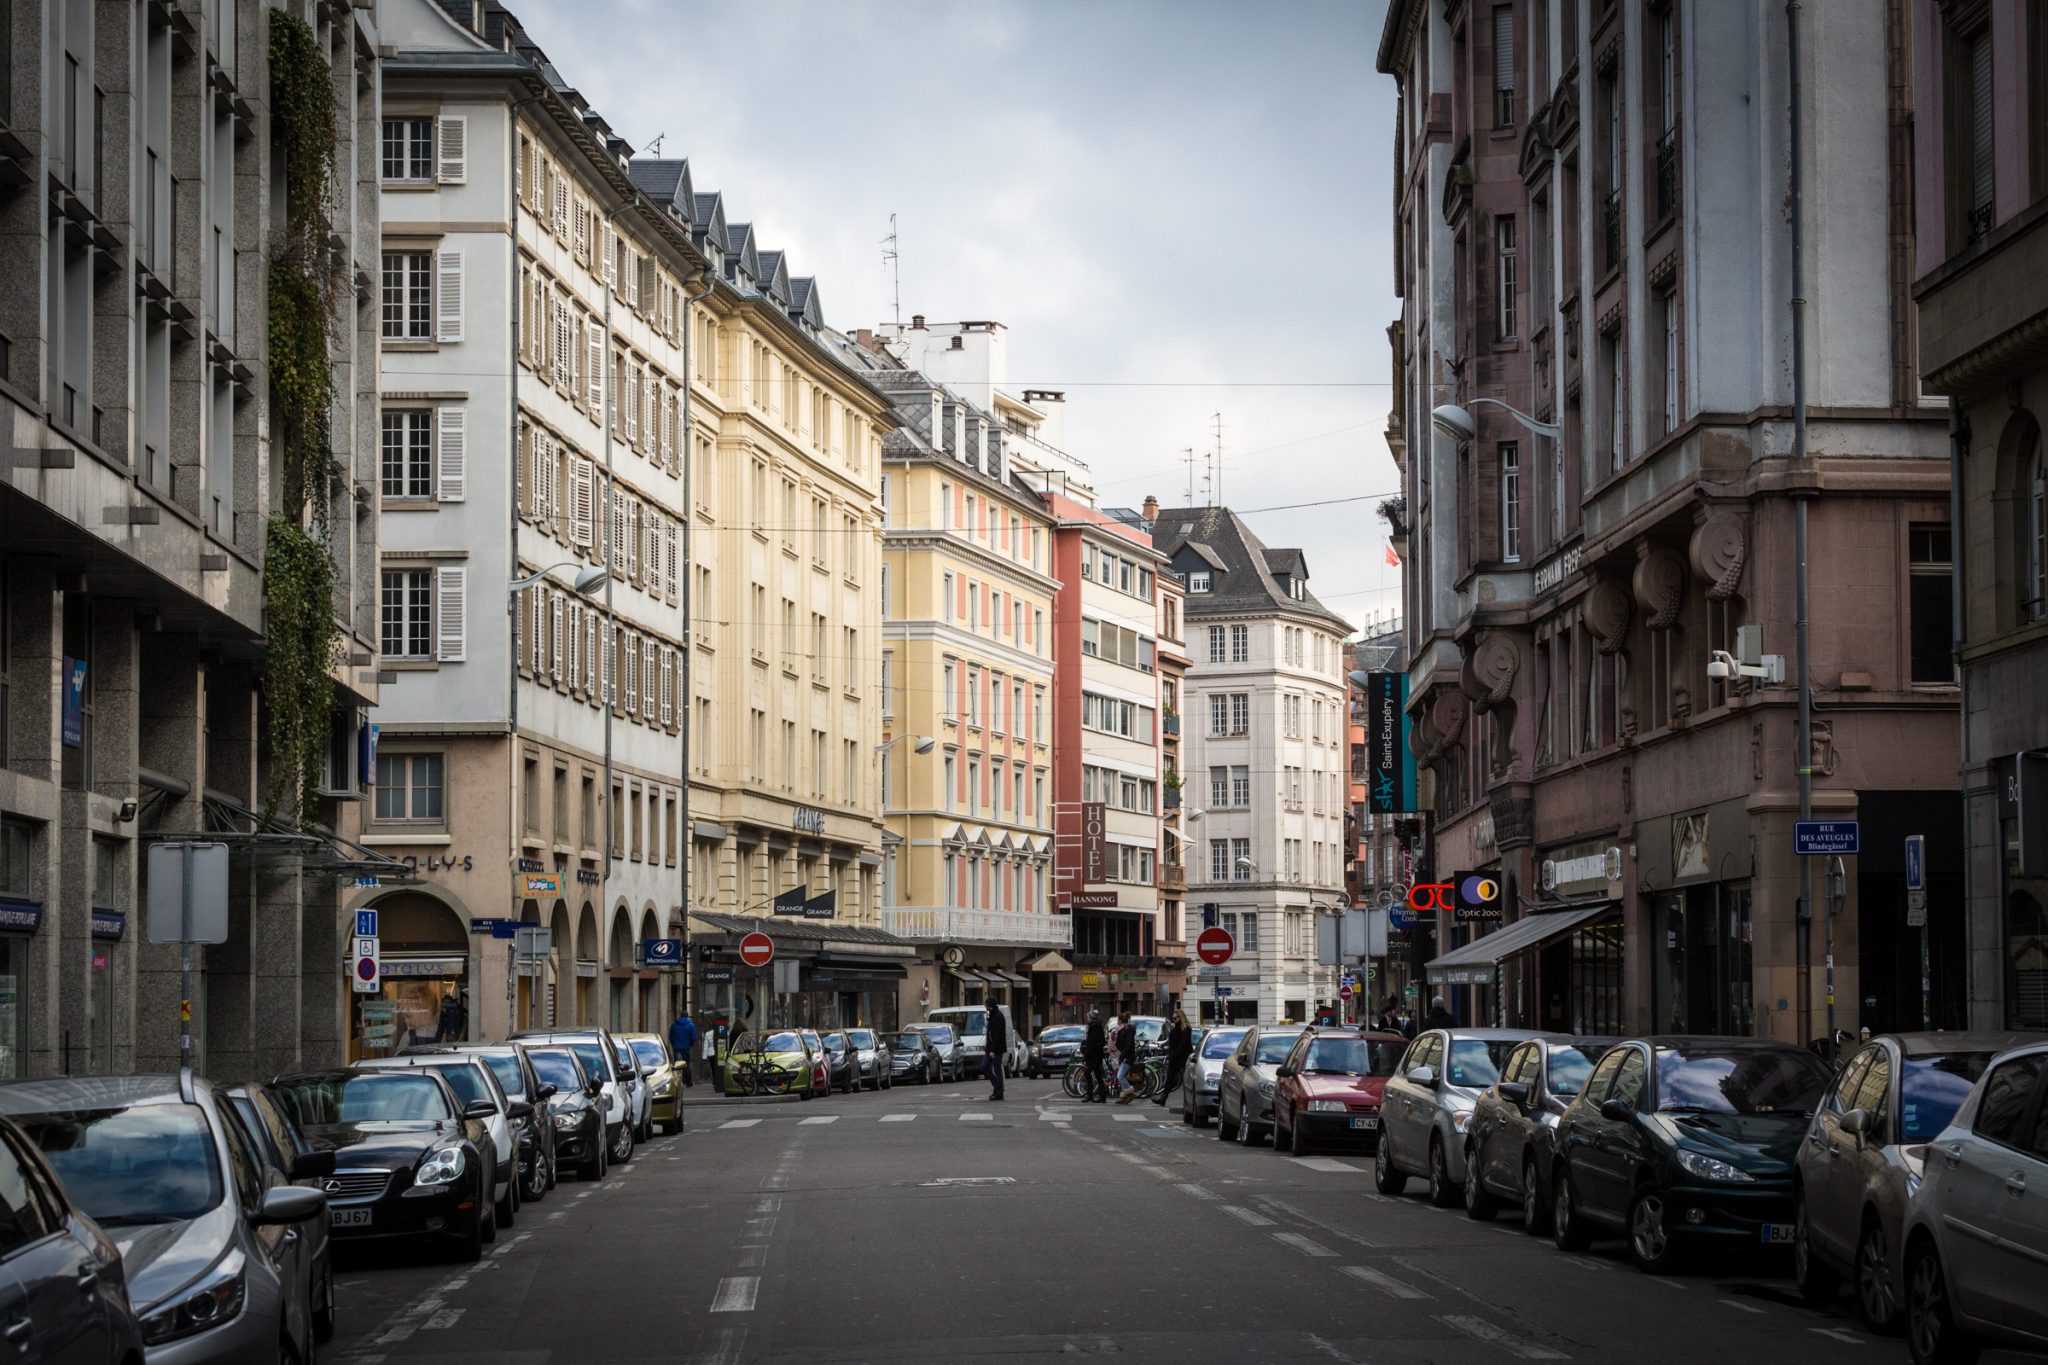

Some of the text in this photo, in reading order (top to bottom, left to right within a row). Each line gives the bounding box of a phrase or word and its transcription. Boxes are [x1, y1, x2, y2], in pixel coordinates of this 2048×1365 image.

[1801, 834, 1854, 842] DES AVEUGLES
[1087, 806, 1102, 881] HOTEL
[1073, 896, 1116, 904] HANNONG
[1392, 908, 1418, 917] Thomas
[1457, 908, 1479, 919] Optic
[1401, 914, 1418, 922] Cook
[369, 1039, 388, 1047] 2015
[330, 1210, 369, 1225] BJ67
